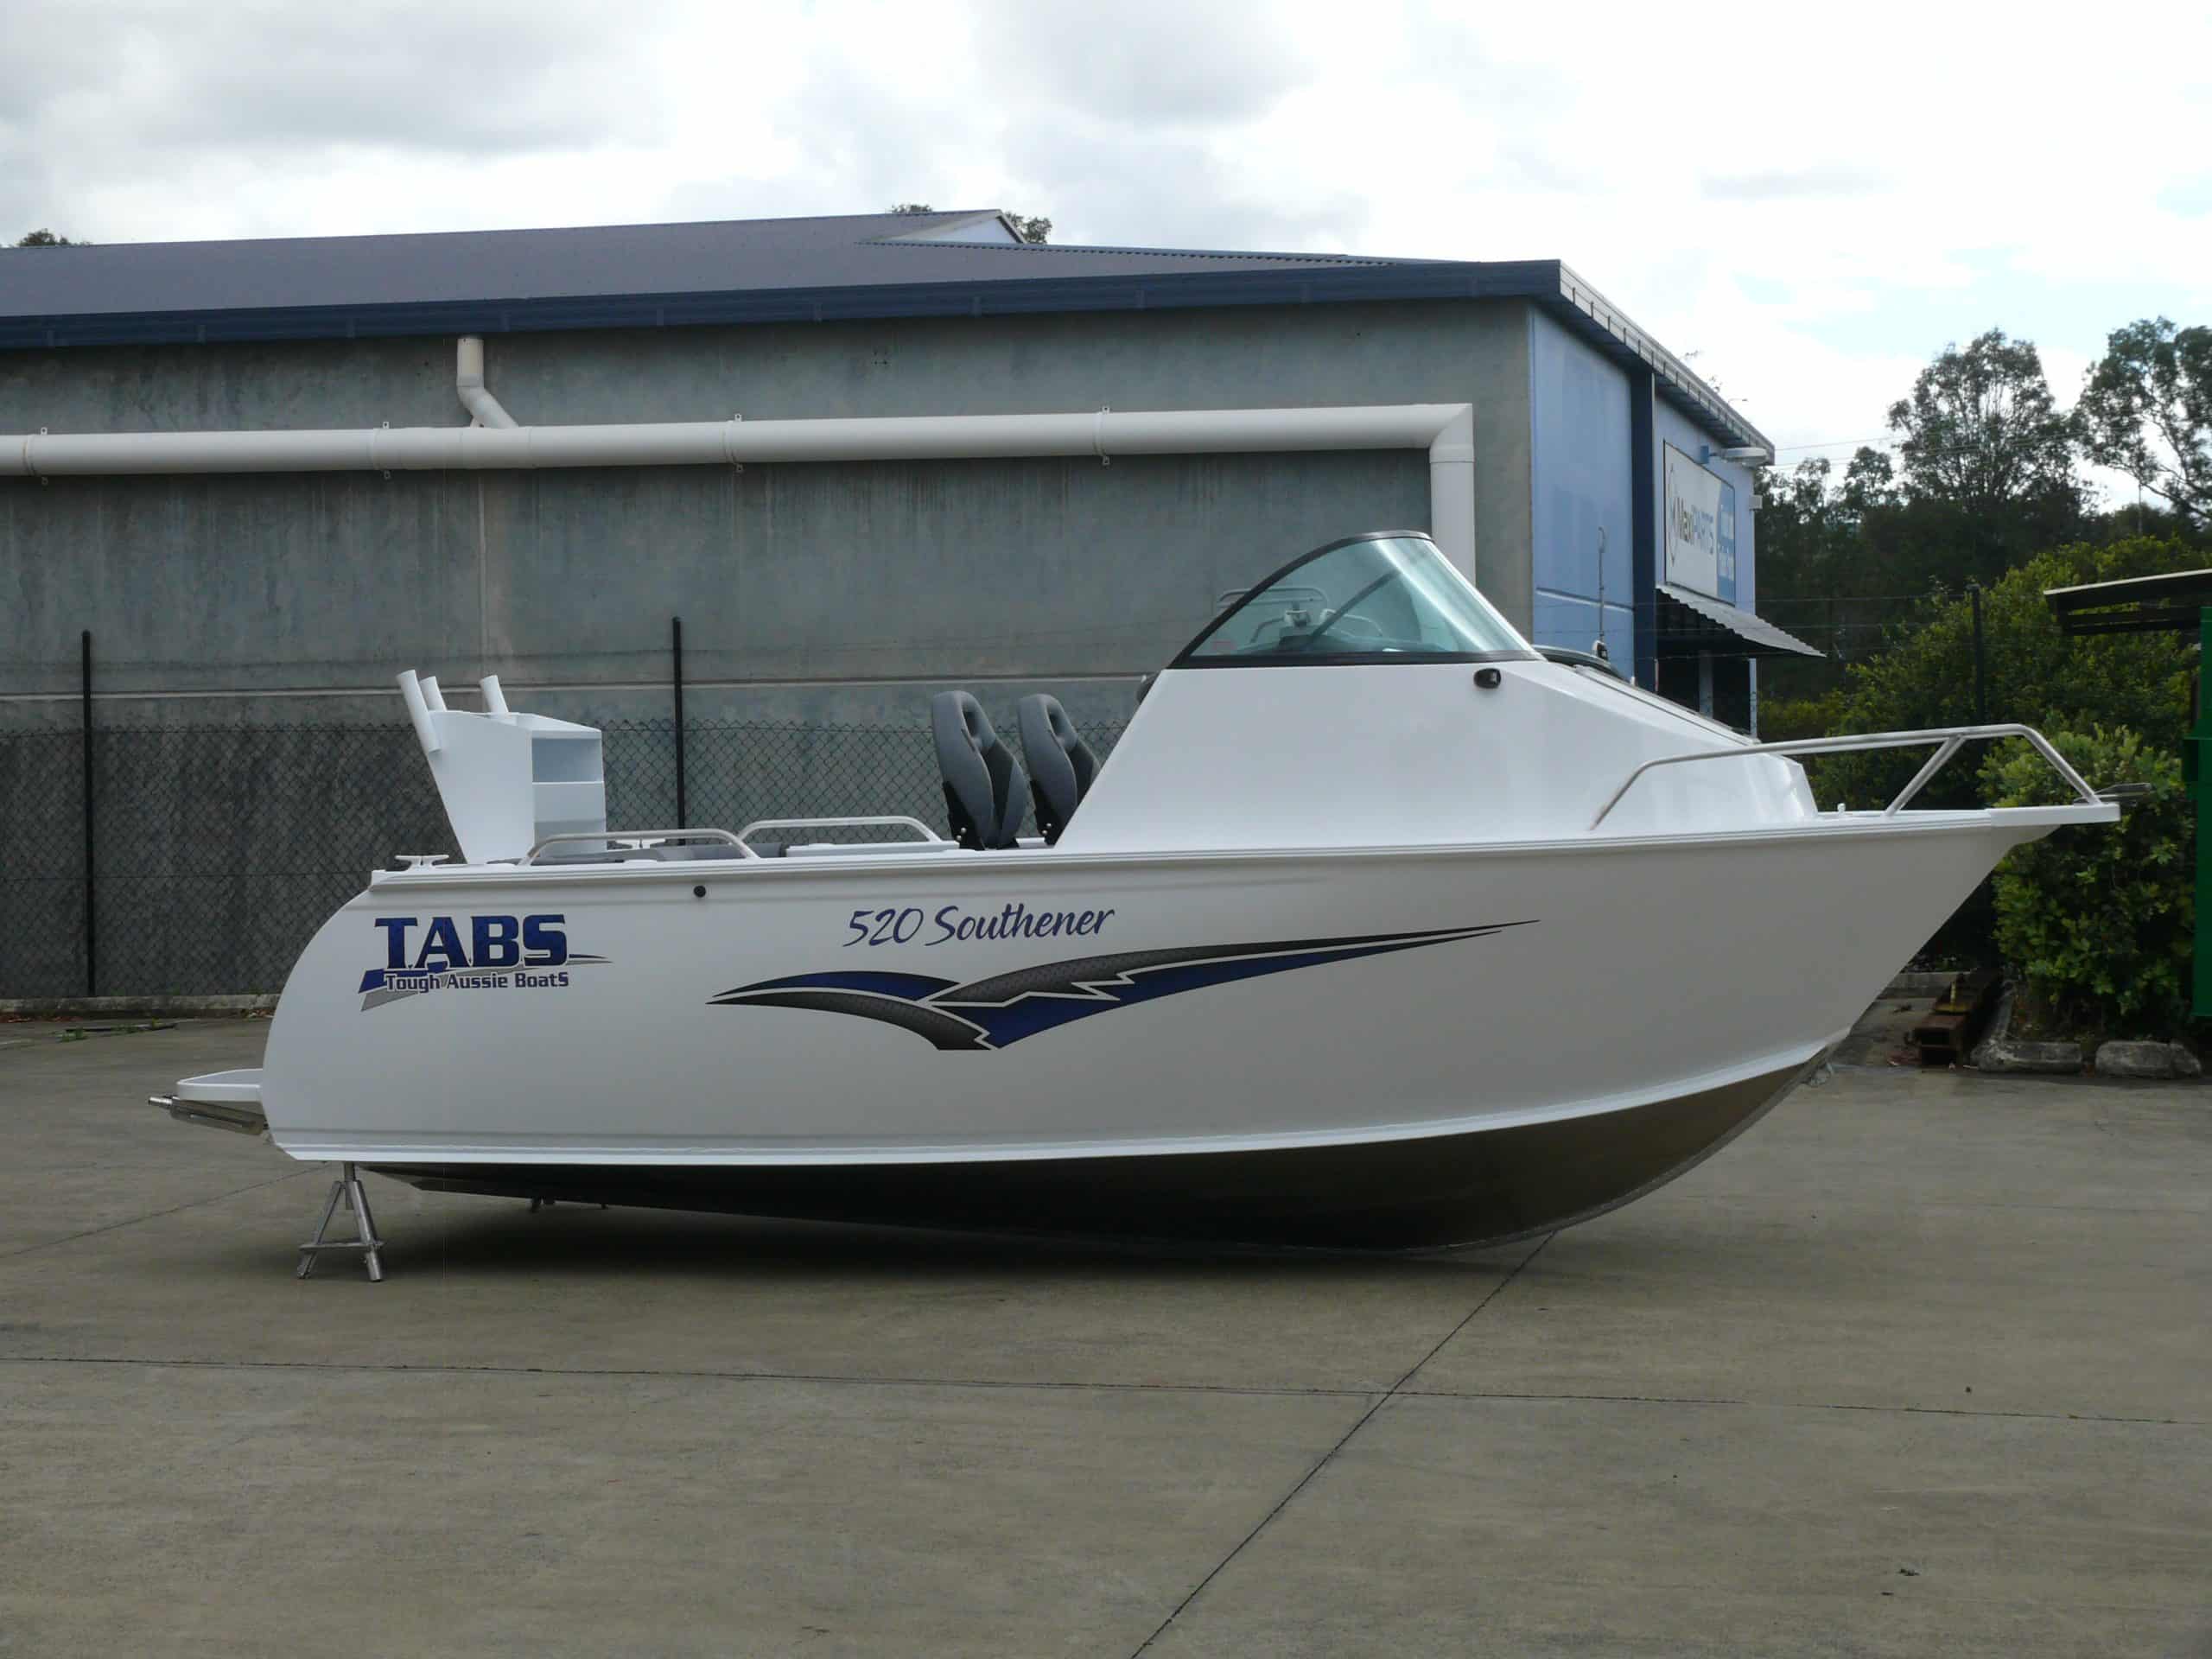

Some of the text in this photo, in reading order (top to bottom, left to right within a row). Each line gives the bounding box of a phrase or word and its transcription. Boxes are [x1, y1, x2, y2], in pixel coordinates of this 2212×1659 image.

[375, 914, 568, 969] TABS
[842, 903, 1115, 947] 520 Southener
[385, 974, 441, 994] Tough
[447, 973, 508, 988] Aussie
